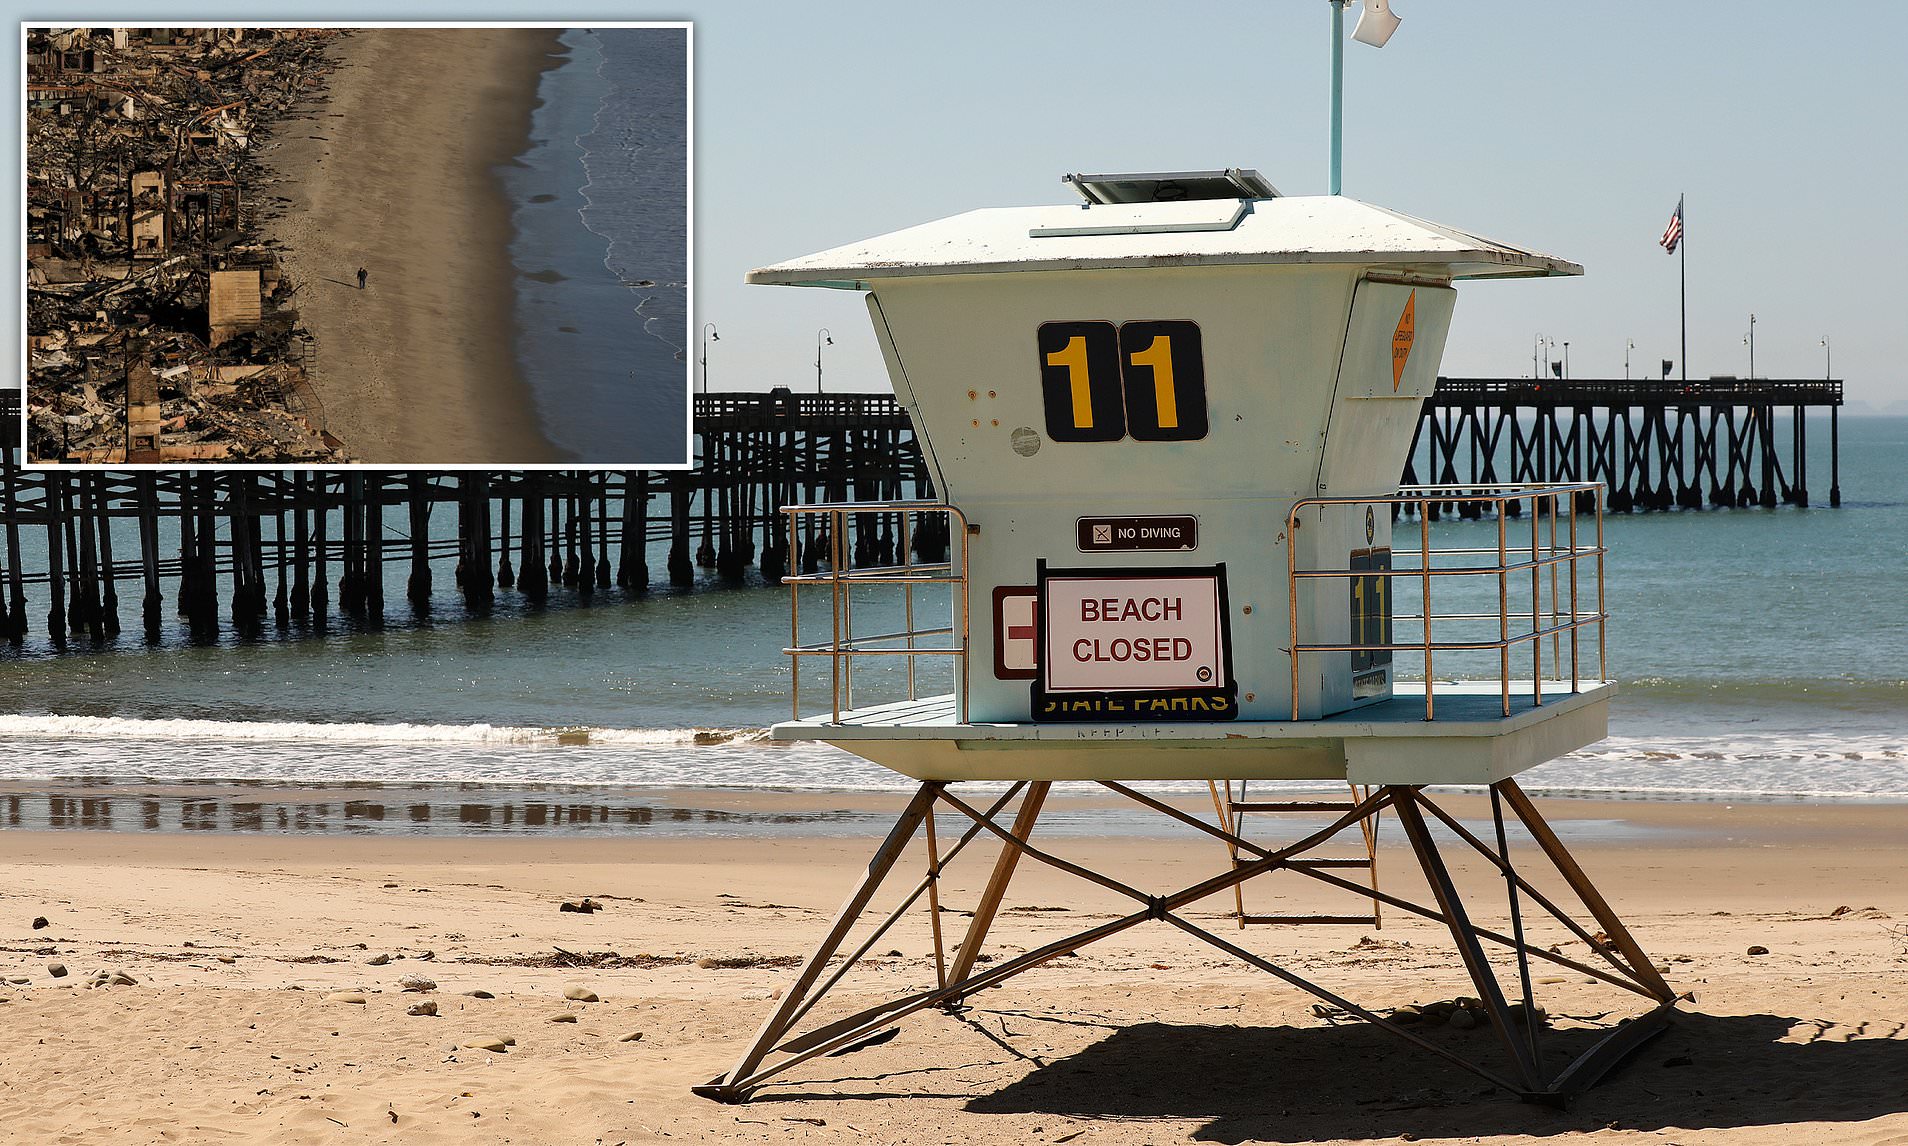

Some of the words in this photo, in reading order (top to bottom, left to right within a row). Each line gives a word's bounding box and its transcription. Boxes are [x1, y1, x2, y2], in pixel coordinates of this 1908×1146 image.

[1046, 335, 1178, 428] 11
[1117, 528, 1136, 539] NO
[1140, 527, 1181, 539] DIVING
[1080, 598, 1182, 622] BEACH
[1354, 564, 1386, 658] 11
[1072, 638, 1193, 662] CLOSED
